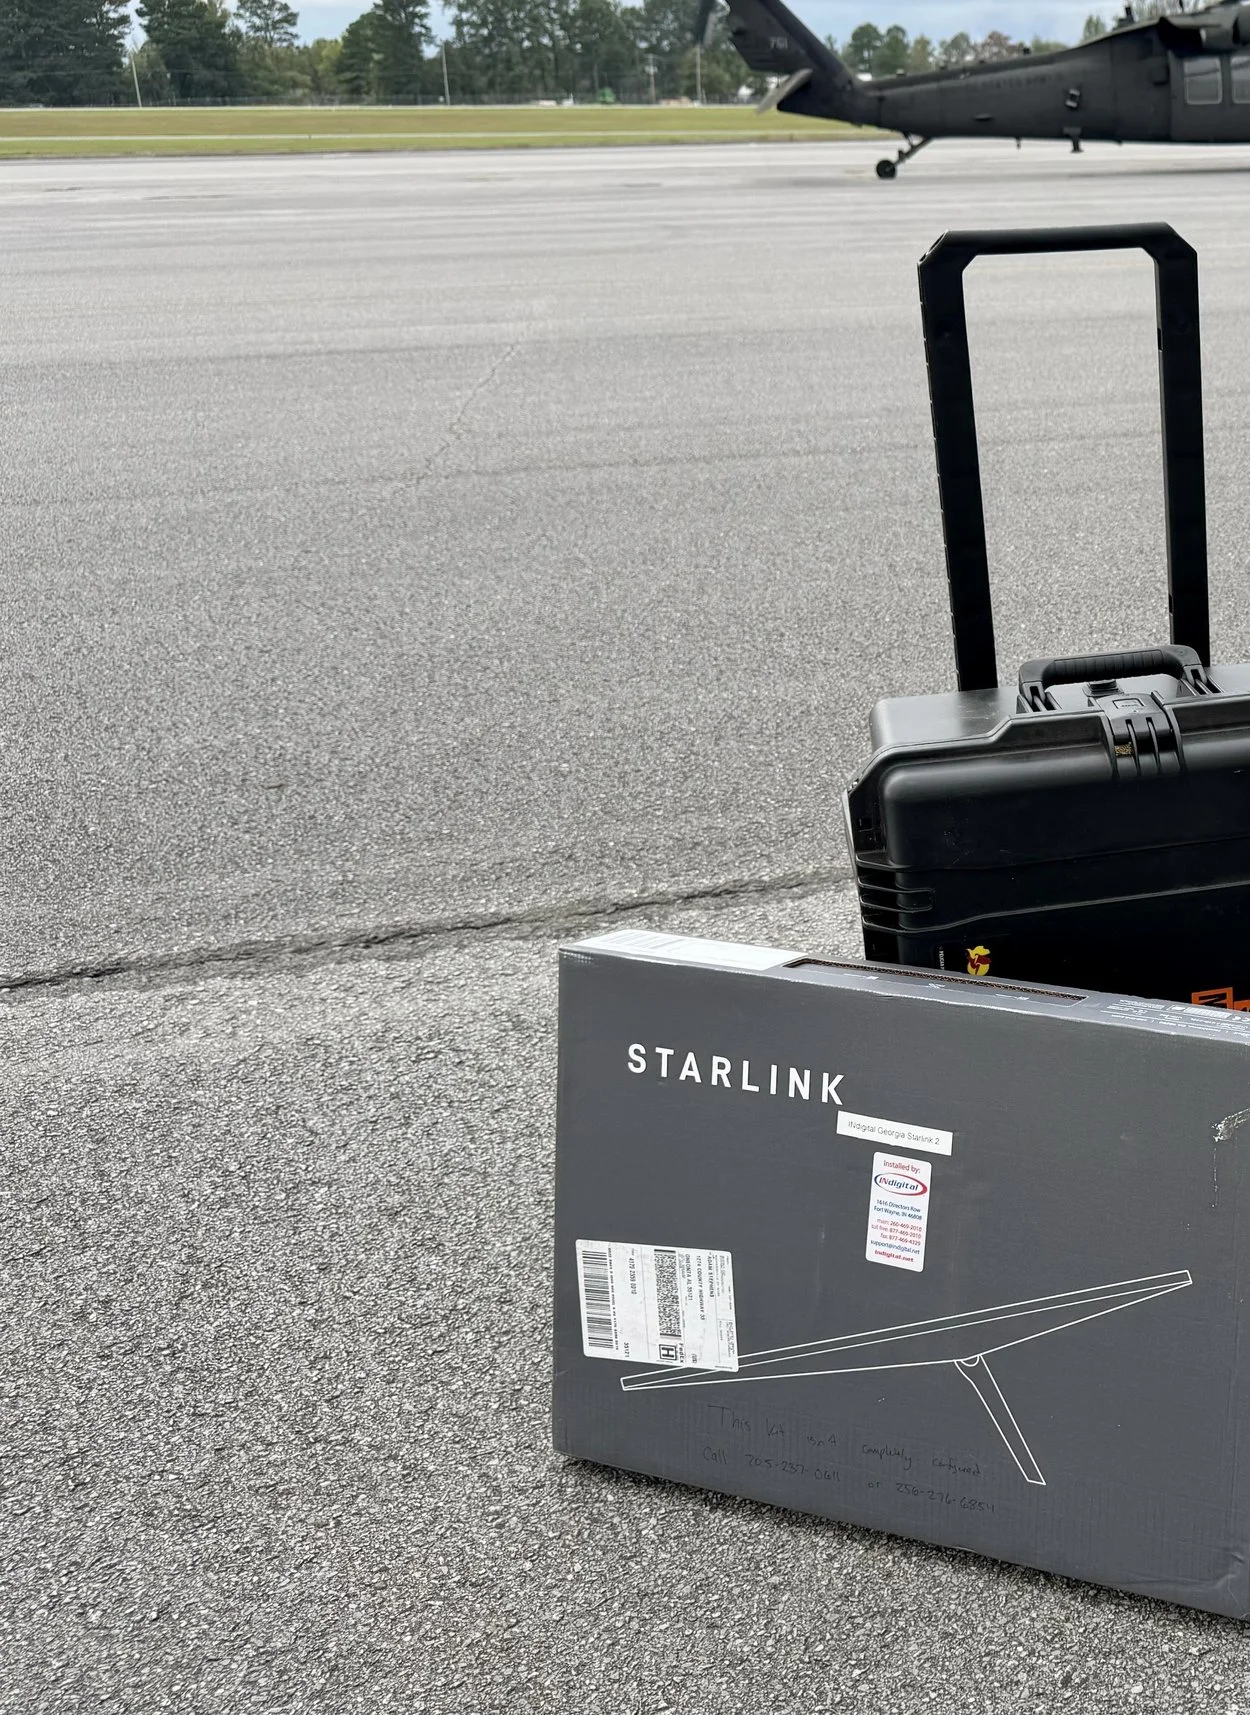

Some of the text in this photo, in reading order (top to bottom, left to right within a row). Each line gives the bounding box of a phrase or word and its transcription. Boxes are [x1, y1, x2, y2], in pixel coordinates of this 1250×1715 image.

[627, 1043, 845, 1105] STARLINK
[877, 1126, 905, 1140] Georgia
[907, 1131, 932, 1143] Starlink
[934, 1137, 939, 1145] 2
[883, 1159, 920, 1175] Installed by:
[878, 1176, 918, 1192] INdigital
[661, 1346, 674, 1358] H
[707, 1405, 752, 1431] This
[703, 1446, 727, 1465] Call
